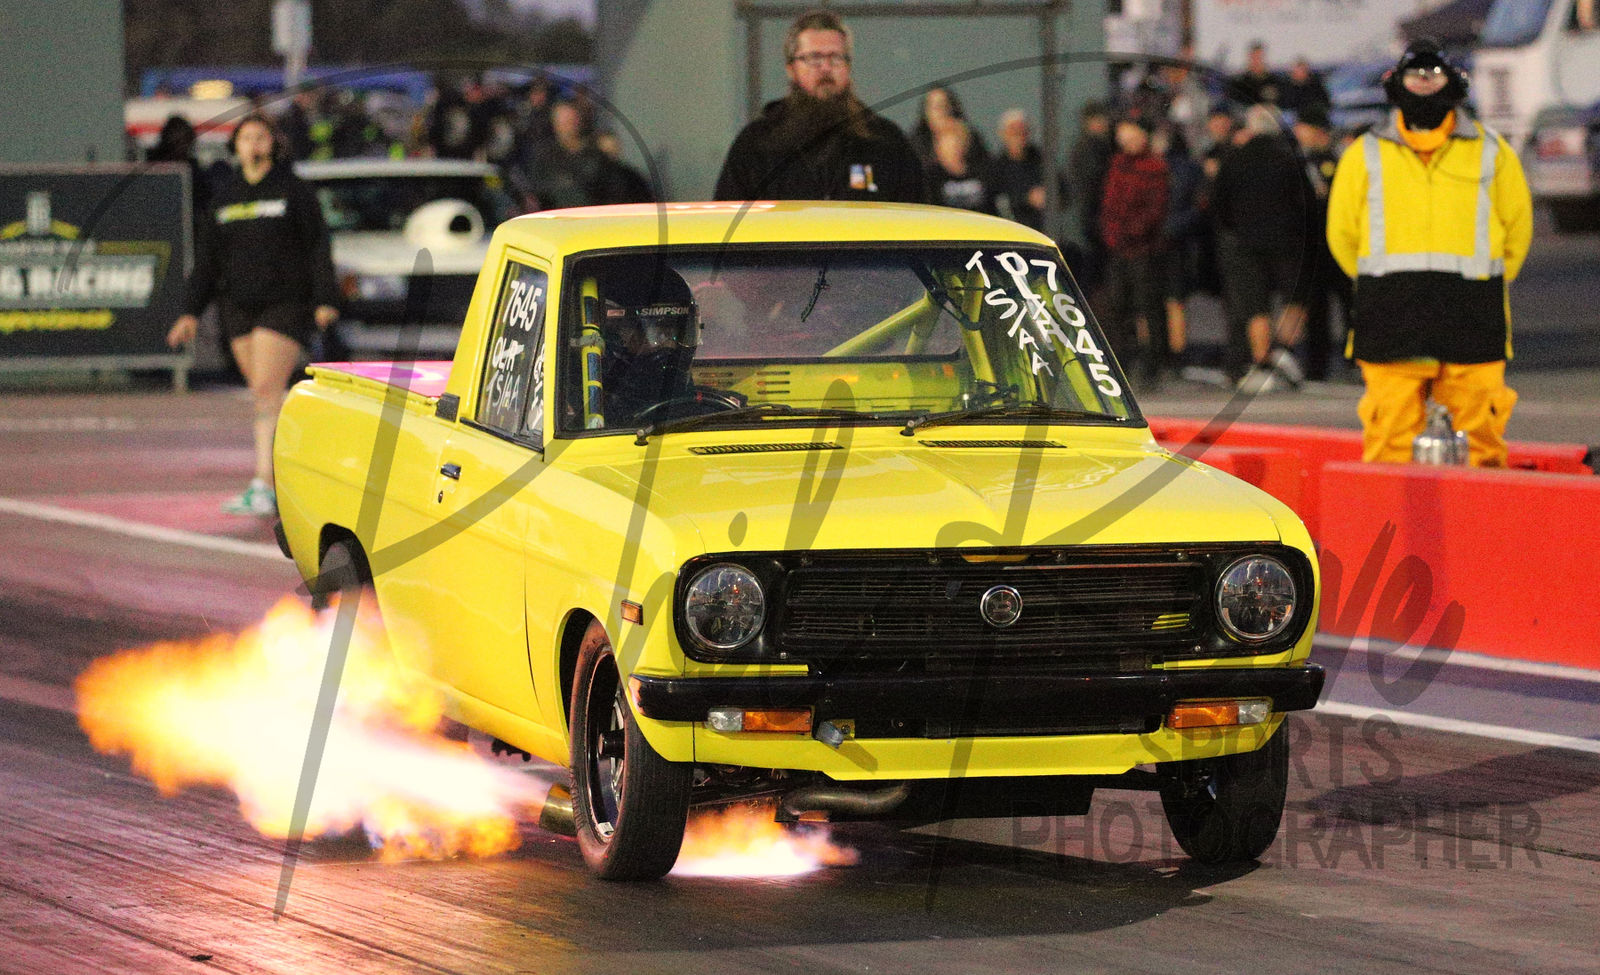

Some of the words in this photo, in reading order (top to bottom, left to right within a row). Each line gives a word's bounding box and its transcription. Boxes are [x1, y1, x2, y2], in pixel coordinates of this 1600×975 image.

[502, 280, 542, 332] 7645
[641, 306, 690, 316] SIMPSON
[1029, 259, 1122, 397] 7645
